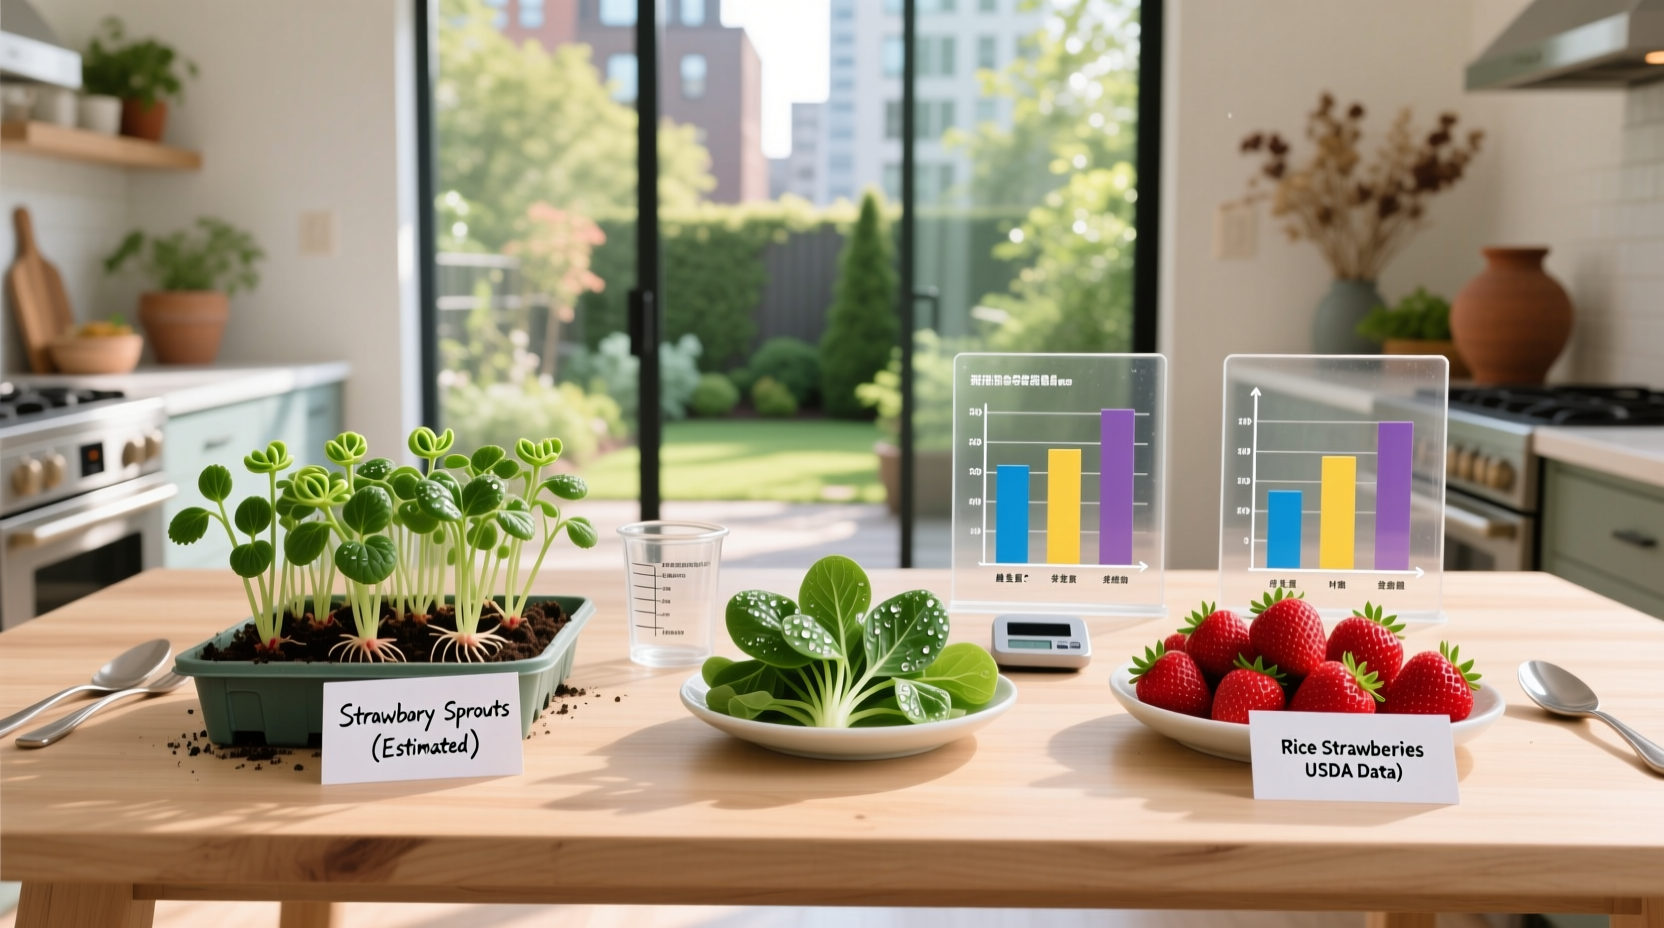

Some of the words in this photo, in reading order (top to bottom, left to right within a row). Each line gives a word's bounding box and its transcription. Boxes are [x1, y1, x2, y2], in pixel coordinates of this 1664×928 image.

[444, 700, 510, 729] Sprouts
[371, 728, 480, 763] (Estimated)
[1281, 739, 1318, 755] Rice
[1321, 740, 1424, 758] Strawberies
[1305, 762, 1354, 778] USDA
[1357, 762, 1403, 782] Data)
